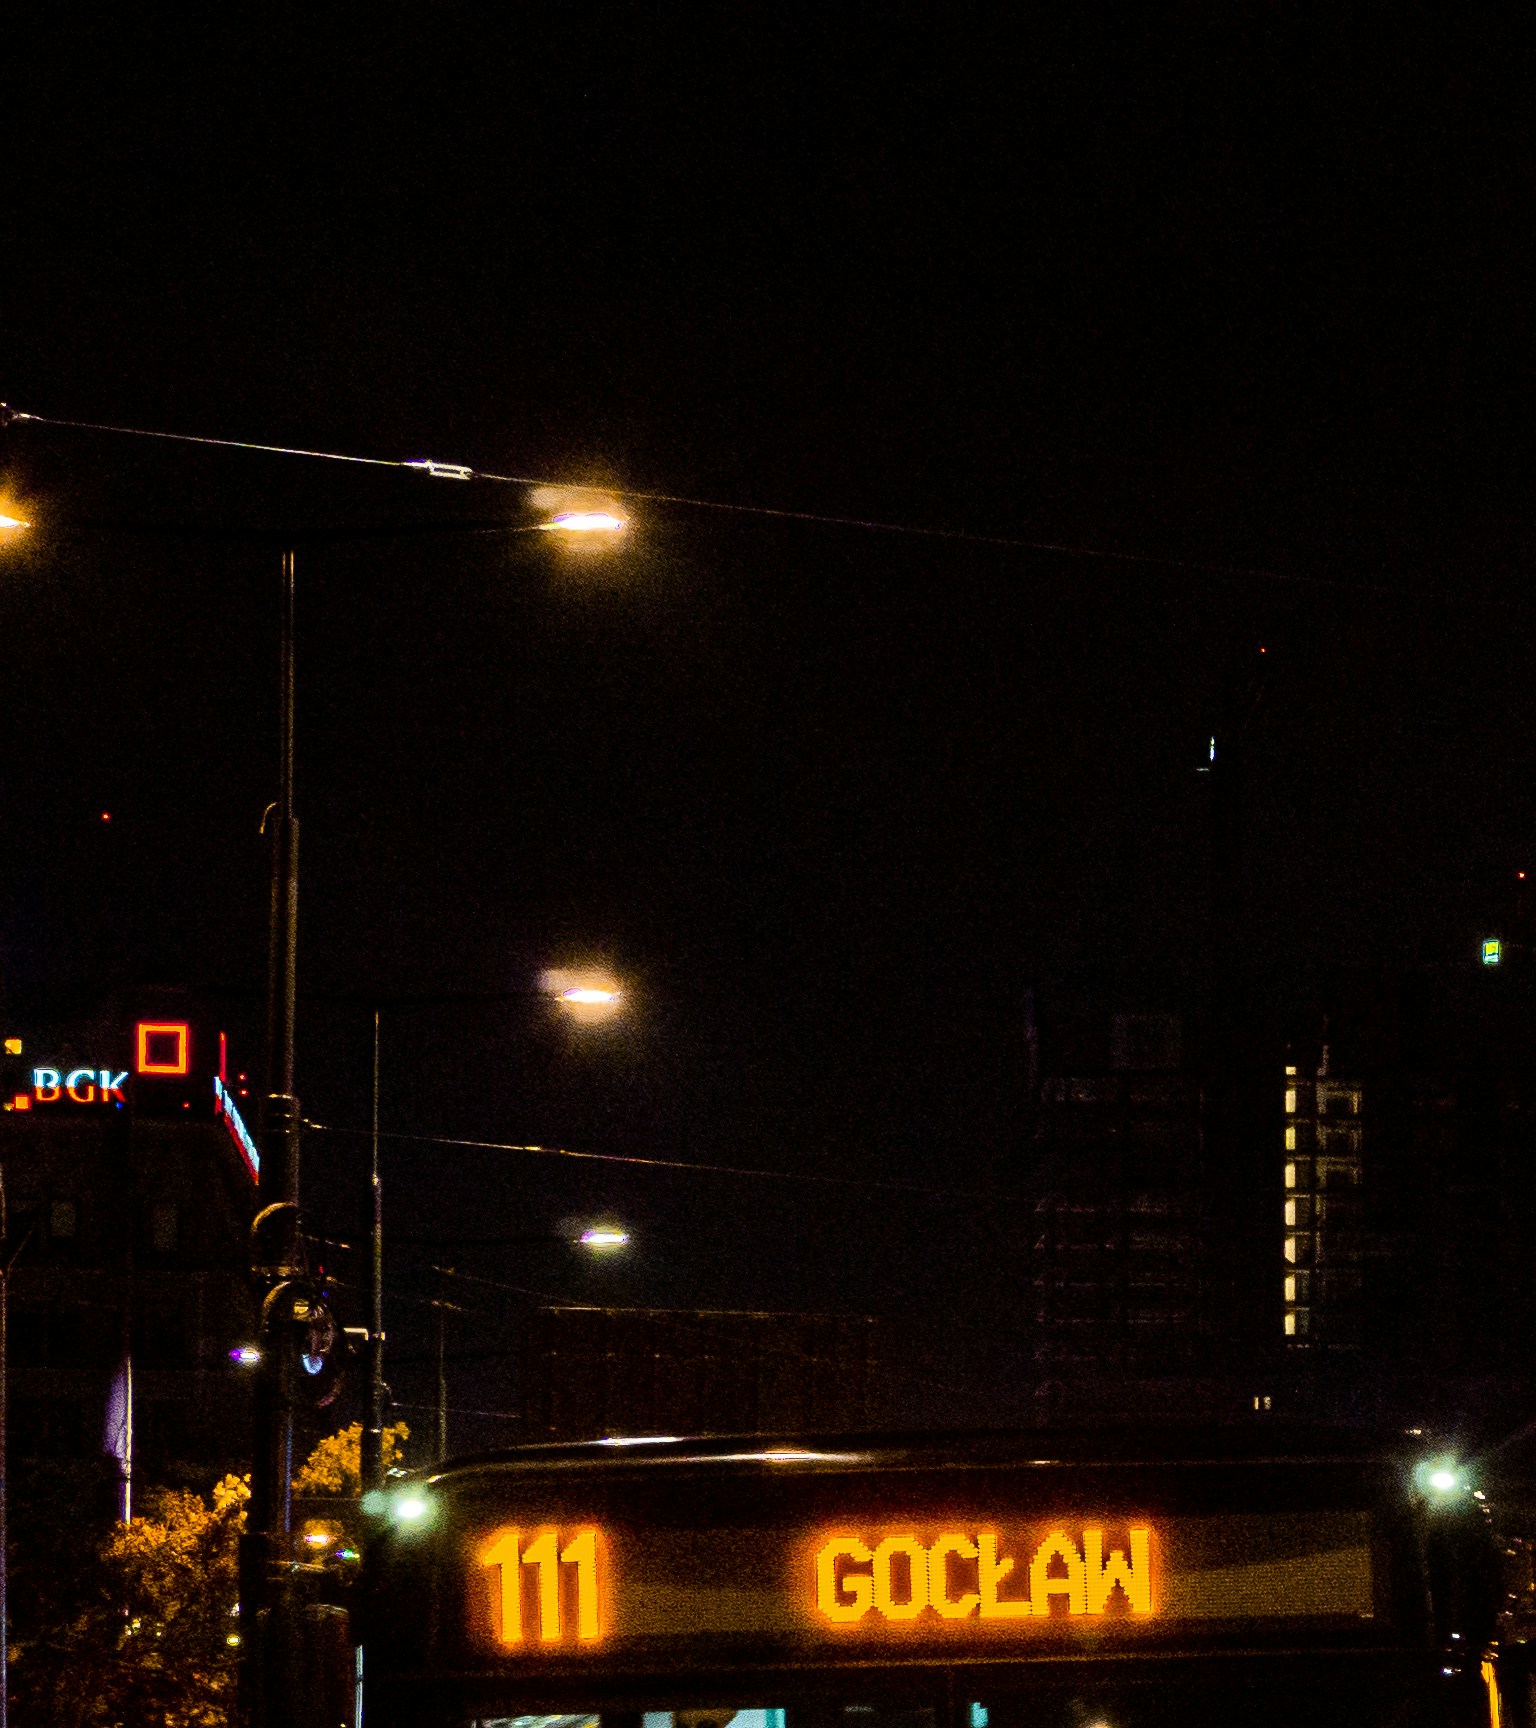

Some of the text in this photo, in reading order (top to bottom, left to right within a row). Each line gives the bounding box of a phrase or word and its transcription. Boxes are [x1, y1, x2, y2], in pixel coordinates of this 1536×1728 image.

[33, 1067, 129, 1102] BGK
[484, 1529, 1152, 1642] 111 GOCŁAW
